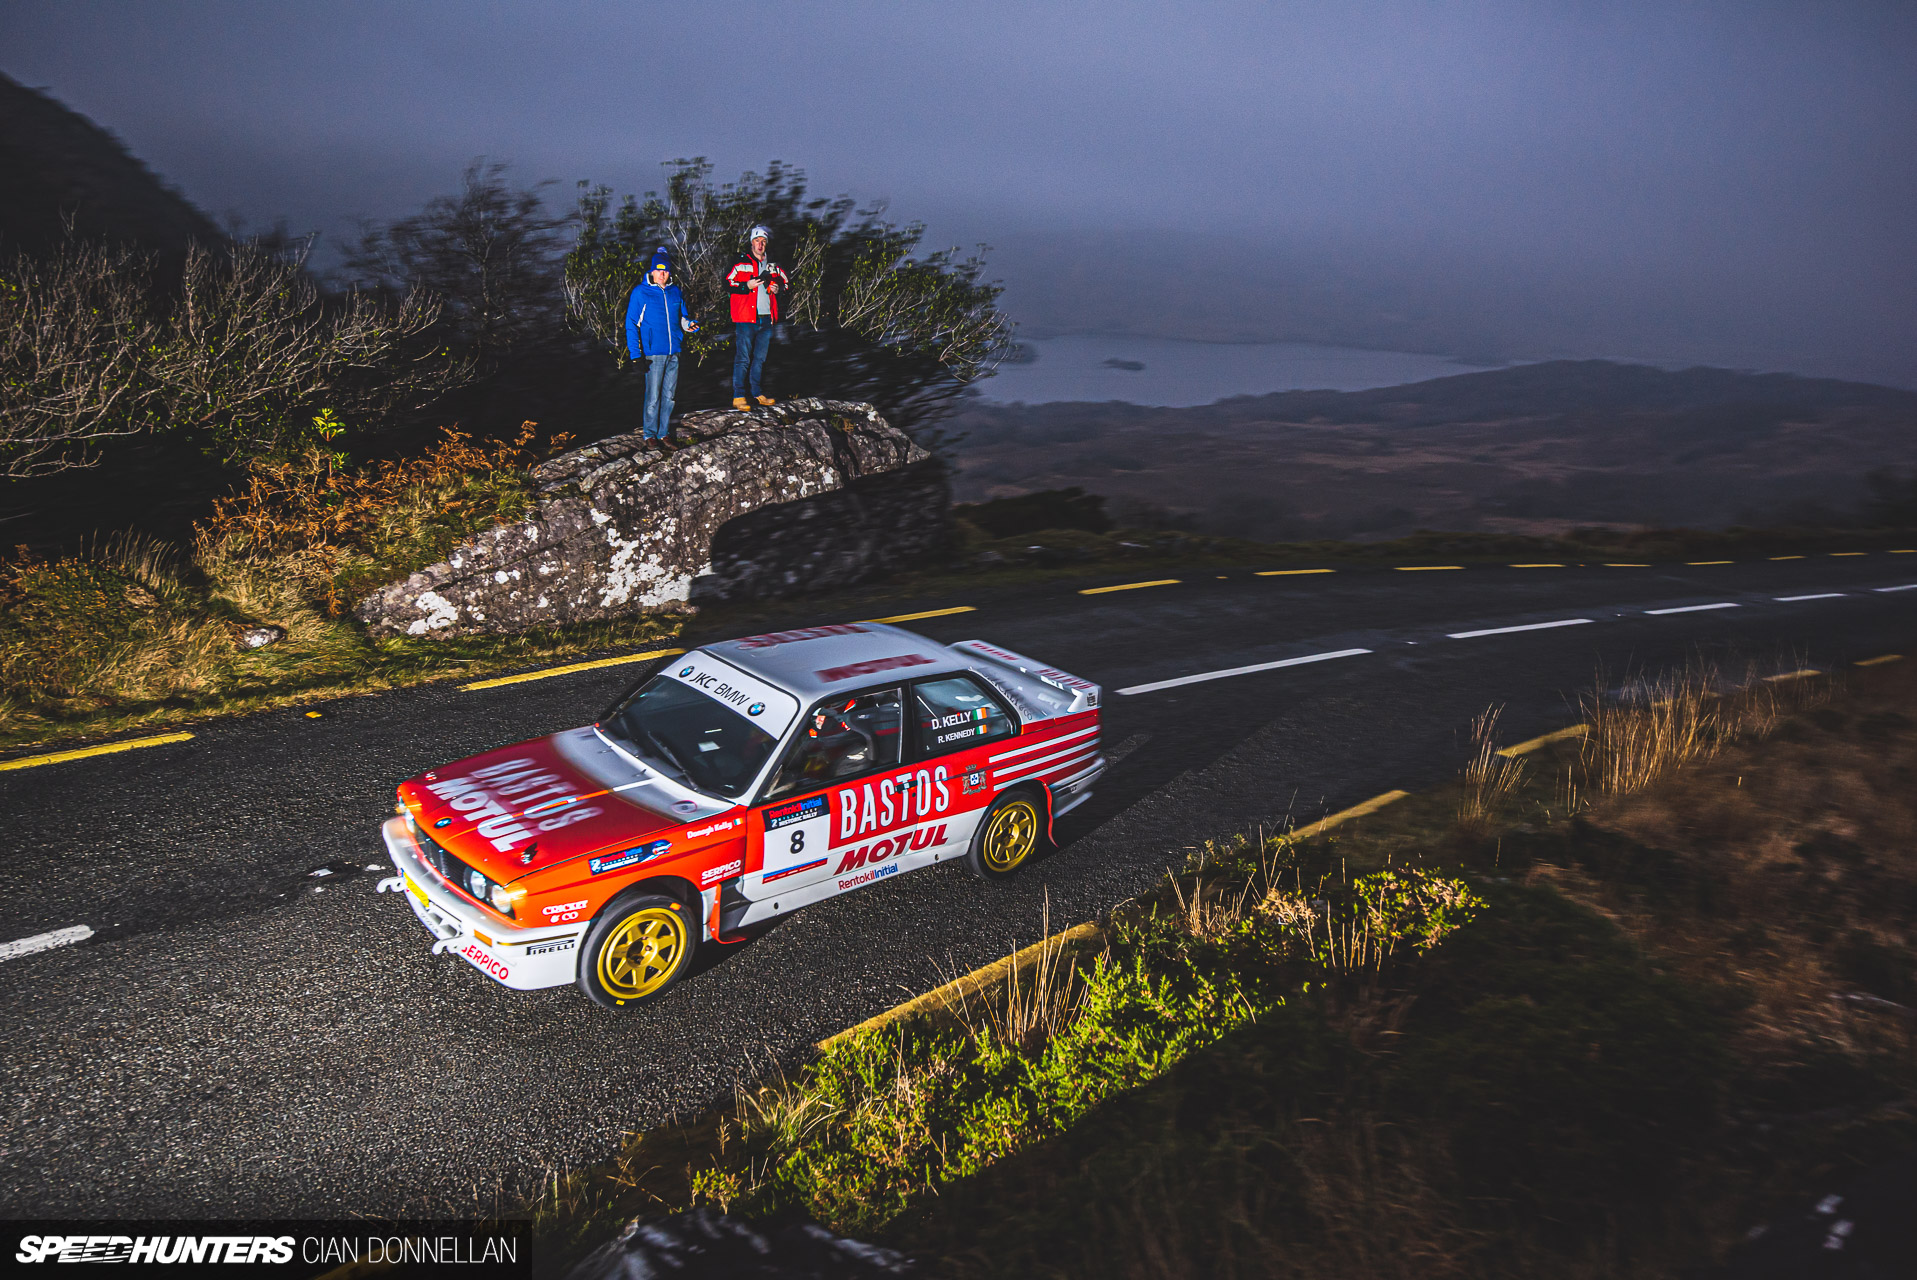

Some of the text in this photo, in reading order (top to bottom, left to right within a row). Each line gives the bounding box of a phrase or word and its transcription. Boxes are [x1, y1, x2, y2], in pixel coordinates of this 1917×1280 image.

[688, 672, 751, 706] JKC BMW
[931, 711, 971, 730] D. KELLY
[937, 727, 976, 744] R. KENNEDY
[426, 776, 538, 853] MOTUL
[839, 765, 950, 841] BASTOS
[714, 821, 733, 832] Kelly
[790, 829, 805, 855] 8
[832, 823, 949, 876] MOTUL
[701, 859, 742, 880] SERPICO
[838, 862, 899, 891] RentokilInitial
[550, 911, 579, 923] & CO
[526, 939, 575, 956] PIRELLI
